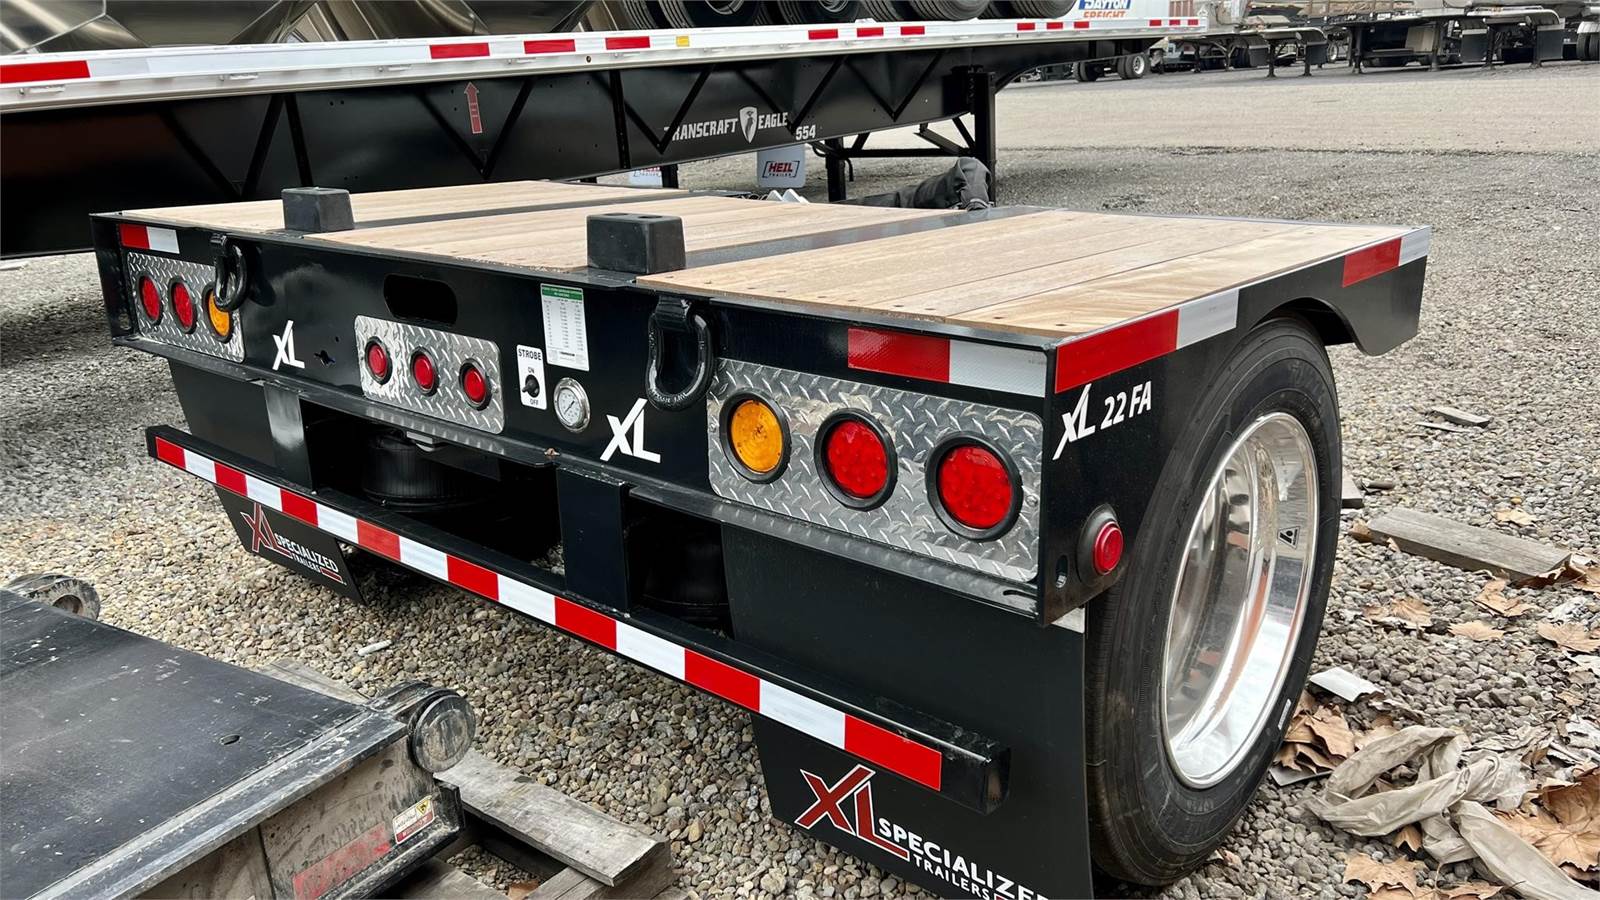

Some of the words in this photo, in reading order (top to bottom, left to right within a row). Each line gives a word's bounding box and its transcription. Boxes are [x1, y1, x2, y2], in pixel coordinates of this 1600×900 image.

[757, 111, 788, 130] EAGLE
[768, 162, 793, 173] HEIL
[272, 319, 305, 371] XL
[518, 348, 542, 361] STROBE
[528, 366, 535, 374] ON
[530, 398, 539, 406] OFF
[1052, 383, 1096, 461] XL
[1100, 391, 1127, 430] 22
[1128, 380, 1152, 418] FA
[600, 397, 661, 464] XL
[240, 502, 293, 560] XL
[274, 532, 339, 573] SPECIALIZED
[291, 552, 321, 573] TRAILERS
[794, 763, 910, 862] XL
[878, 817, 1049, 899] SPECIALIZE
[912, 853, 990, 900] TRAILERS
